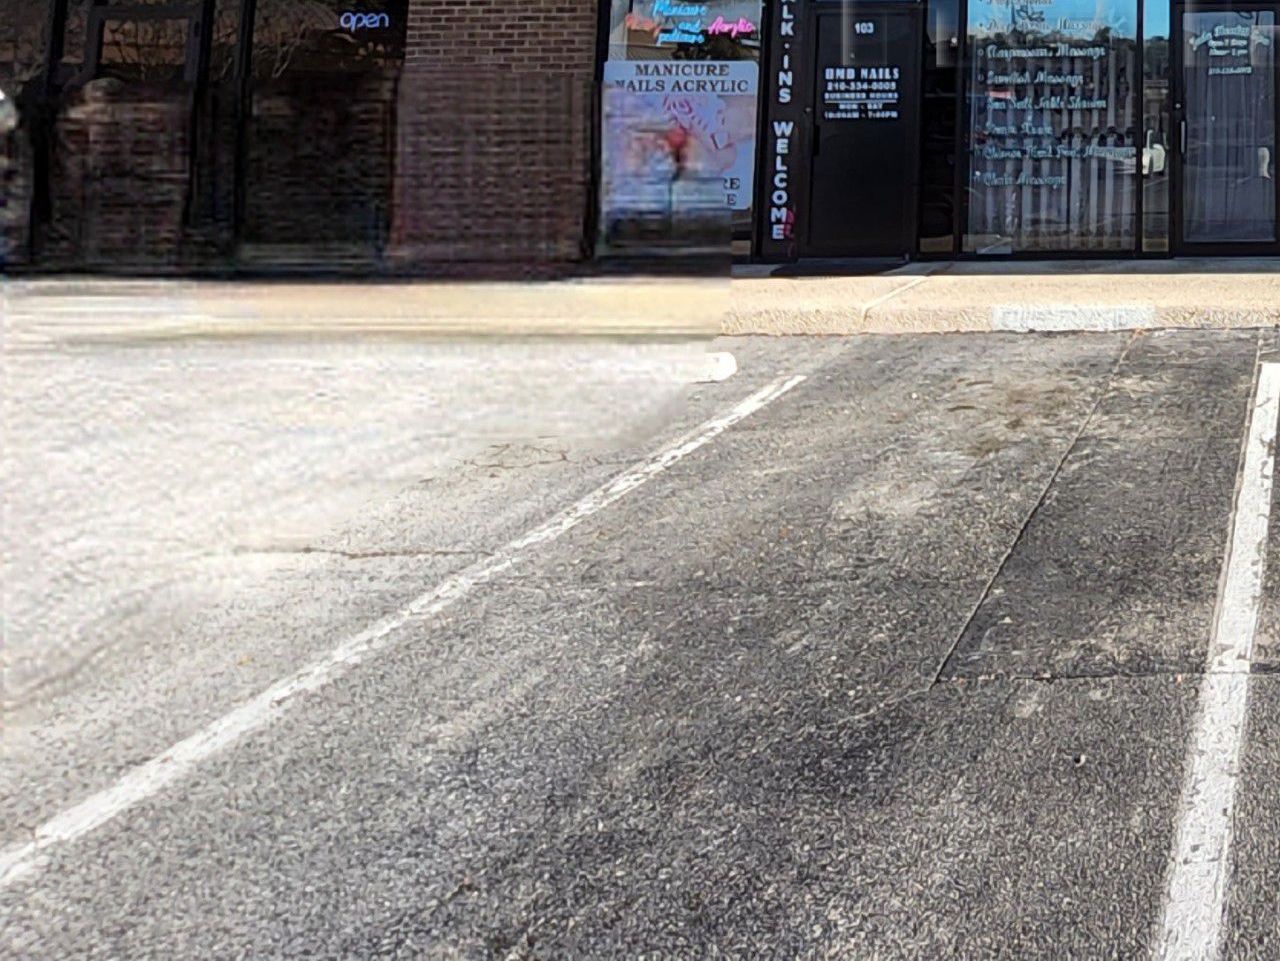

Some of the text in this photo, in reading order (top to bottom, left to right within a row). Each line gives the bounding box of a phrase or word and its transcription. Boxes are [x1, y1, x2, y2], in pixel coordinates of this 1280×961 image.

[708, 16, 756, 38] Acrylic
[854, 22, 875, 34] 103
[635, 64, 730, 76] MANICURE
[860, 68, 900, 80] NAILS
[671, 80, 749, 93] ACRYLIC
[770, 120, 795, 240] WELCOME
